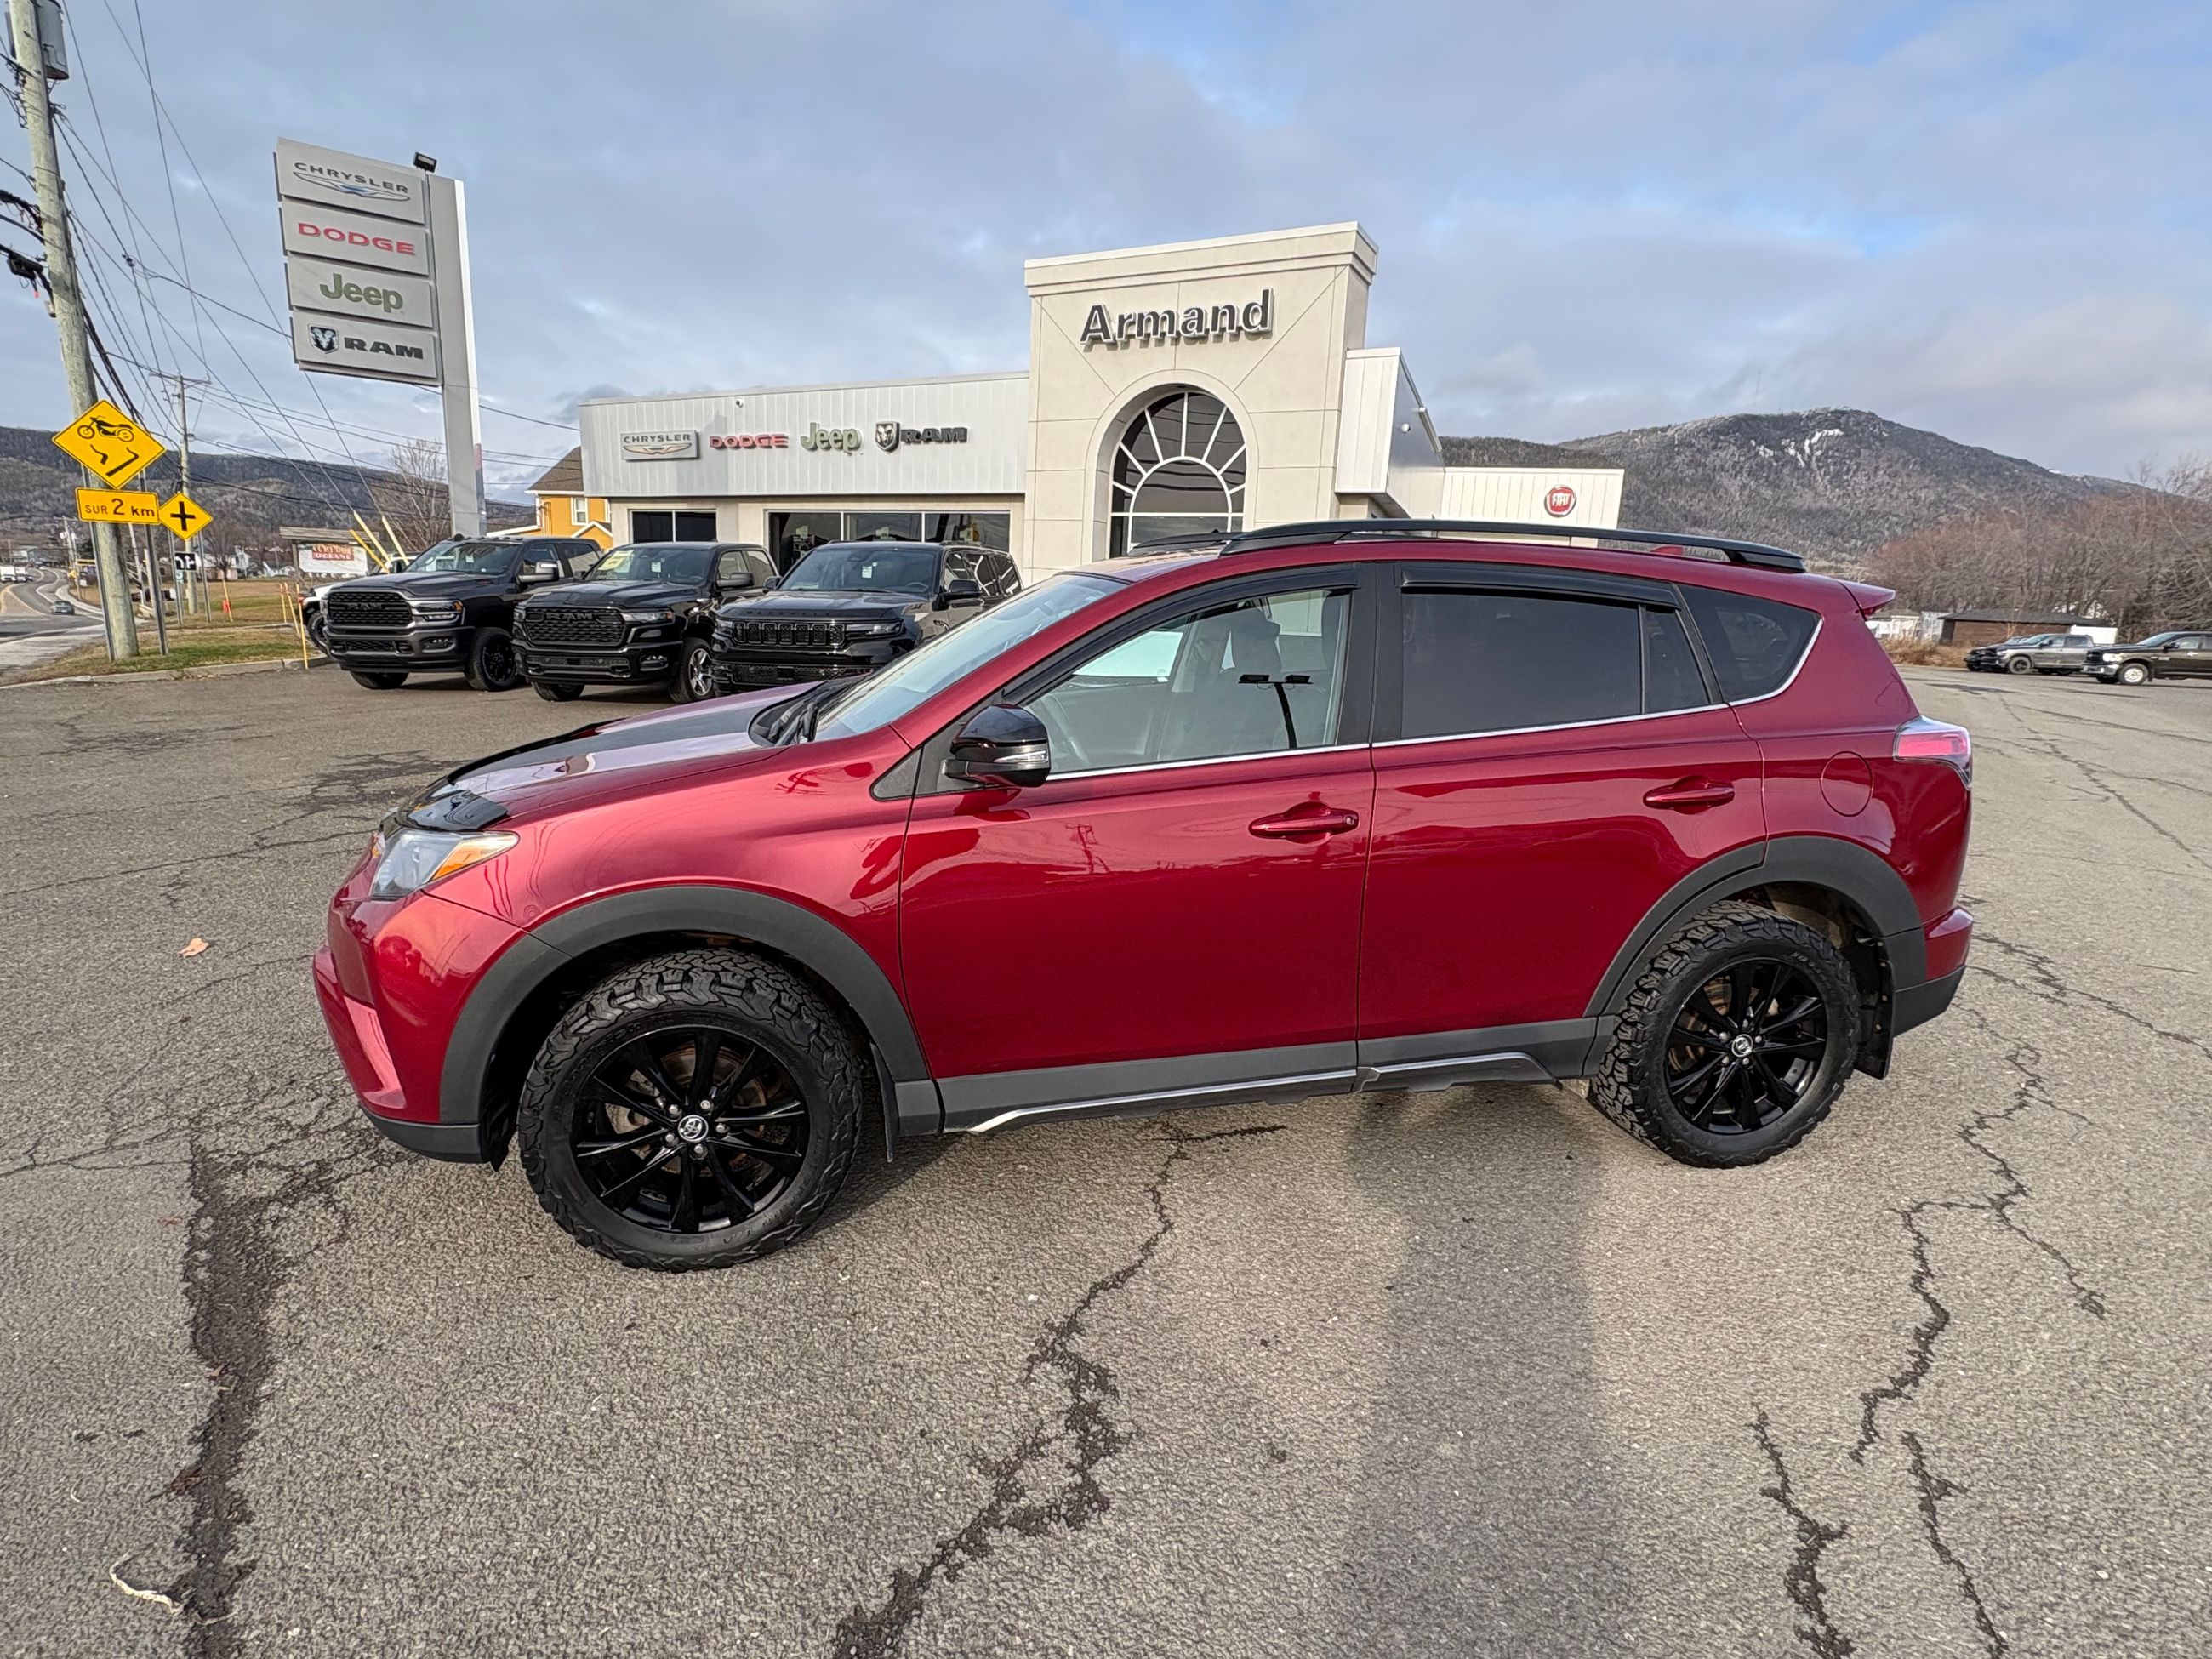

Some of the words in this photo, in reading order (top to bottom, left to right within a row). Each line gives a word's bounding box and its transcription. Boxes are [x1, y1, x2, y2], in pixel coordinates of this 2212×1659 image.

[294, 162, 408, 194] CHRYSLER
[298, 222, 416, 256] DODGE
[319, 272, 404, 313] Jeep
[1080, 287, 1274, 345] Armand
[344, 337, 424, 360] RAM
[623, 433, 691, 443] CHRYSLER
[709, 433, 789, 448] DODGE
[800, 422, 861, 455] Jeep
[900, 427, 968, 444] RAM
[84, 504, 108, 515] SUR
[111, 498, 125, 516] 2
[131, 505, 155, 517] km
[1552, 493, 1571, 507] FIAT
[545, 612, 593, 620] RAM
